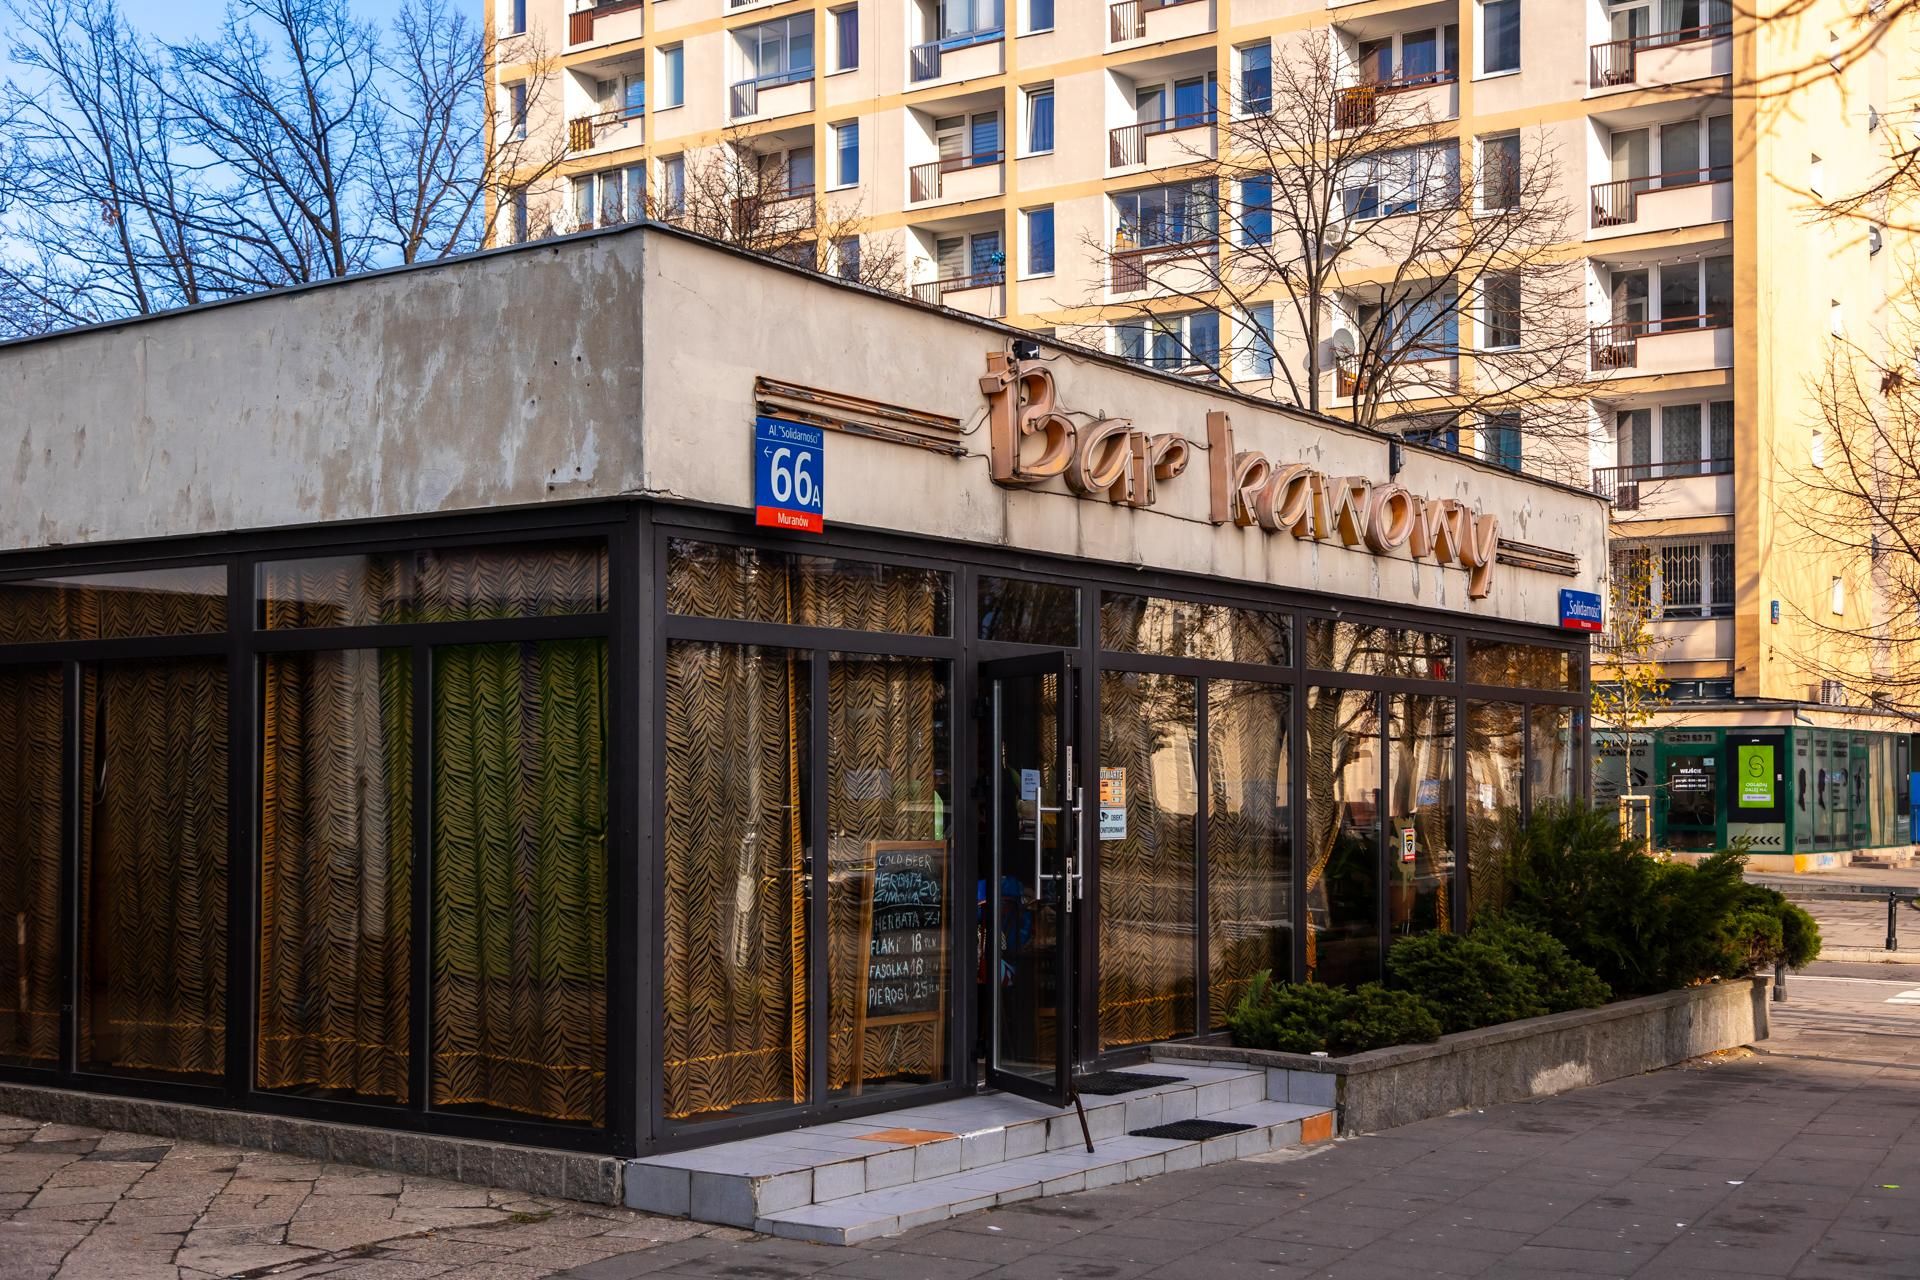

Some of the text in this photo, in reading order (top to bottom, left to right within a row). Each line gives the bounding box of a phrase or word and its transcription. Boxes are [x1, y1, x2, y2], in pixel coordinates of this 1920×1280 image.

[768, 424, 778, 437] Al.
[979, 351, 1499, 599] Bar kawowy
[777, 512, 809, 528] Muranów
[1100, 826, 1124, 834] ONITOROWANY
[879, 854, 932, 872] COLD BEER
[875, 871, 922, 891] HERBATA
[875, 911, 920, 931] HERBATA
